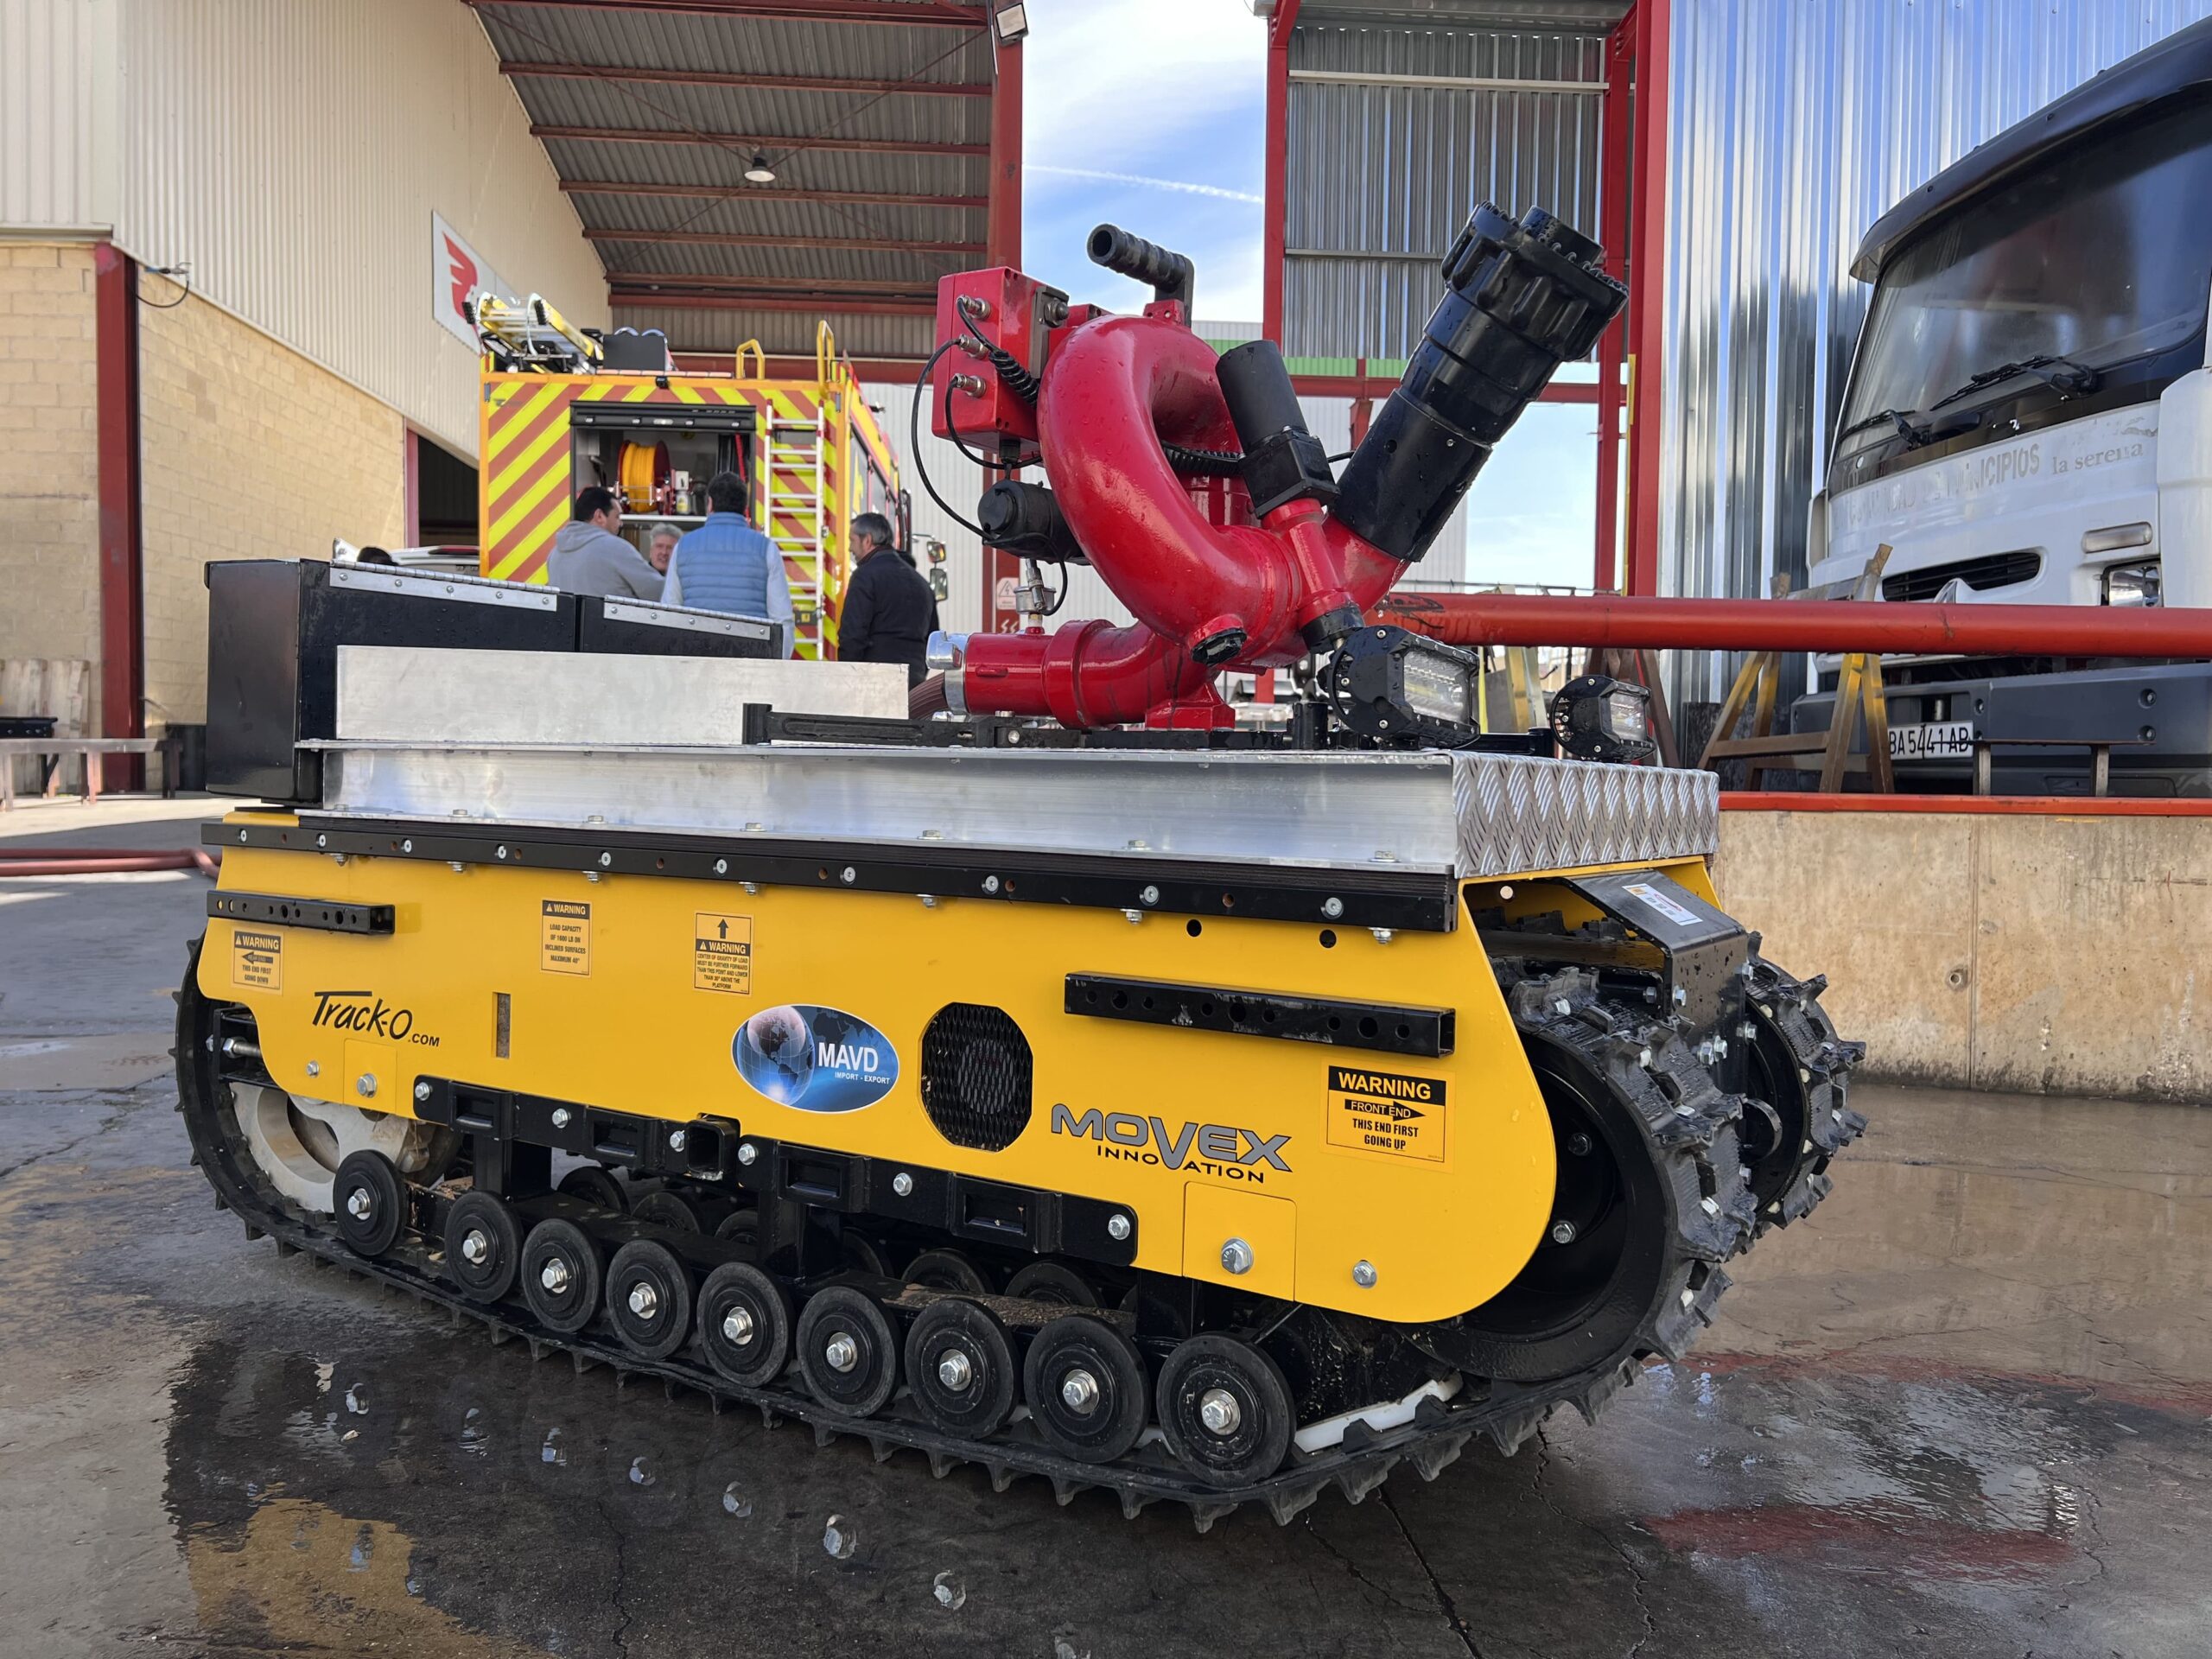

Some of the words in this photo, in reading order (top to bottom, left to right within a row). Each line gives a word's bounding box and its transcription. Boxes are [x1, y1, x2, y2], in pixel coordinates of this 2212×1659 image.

[2052, 456, 2069, 474] la
[1889, 729, 1905, 755] BA
[1908, 728, 1944, 754] 5441
[554, 904, 586, 915] WARNING
[243, 935, 279, 950] WARNING
[709, 941, 746, 954] WARNING
[818, 1042, 879, 1072] MAVD
[835, 1071, 858, 1081] IMPORT
[864, 1075, 890, 1085] EXPORT
[1338, 1071, 1431, 1100] WARNING
[1351, 1101, 1386, 1115] FRONT
[1389, 1107, 1411, 1118] END
[1352, 1118, 1372, 1130] THIS
[1375, 1121, 1391, 1134] END
[1394, 1124, 1419, 1138] FIRST
[1051, 1103, 1293, 1173] MOVEX
[1364, 1135, 1392, 1147] GOING
[1394, 1139, 1406, 1150] UP
